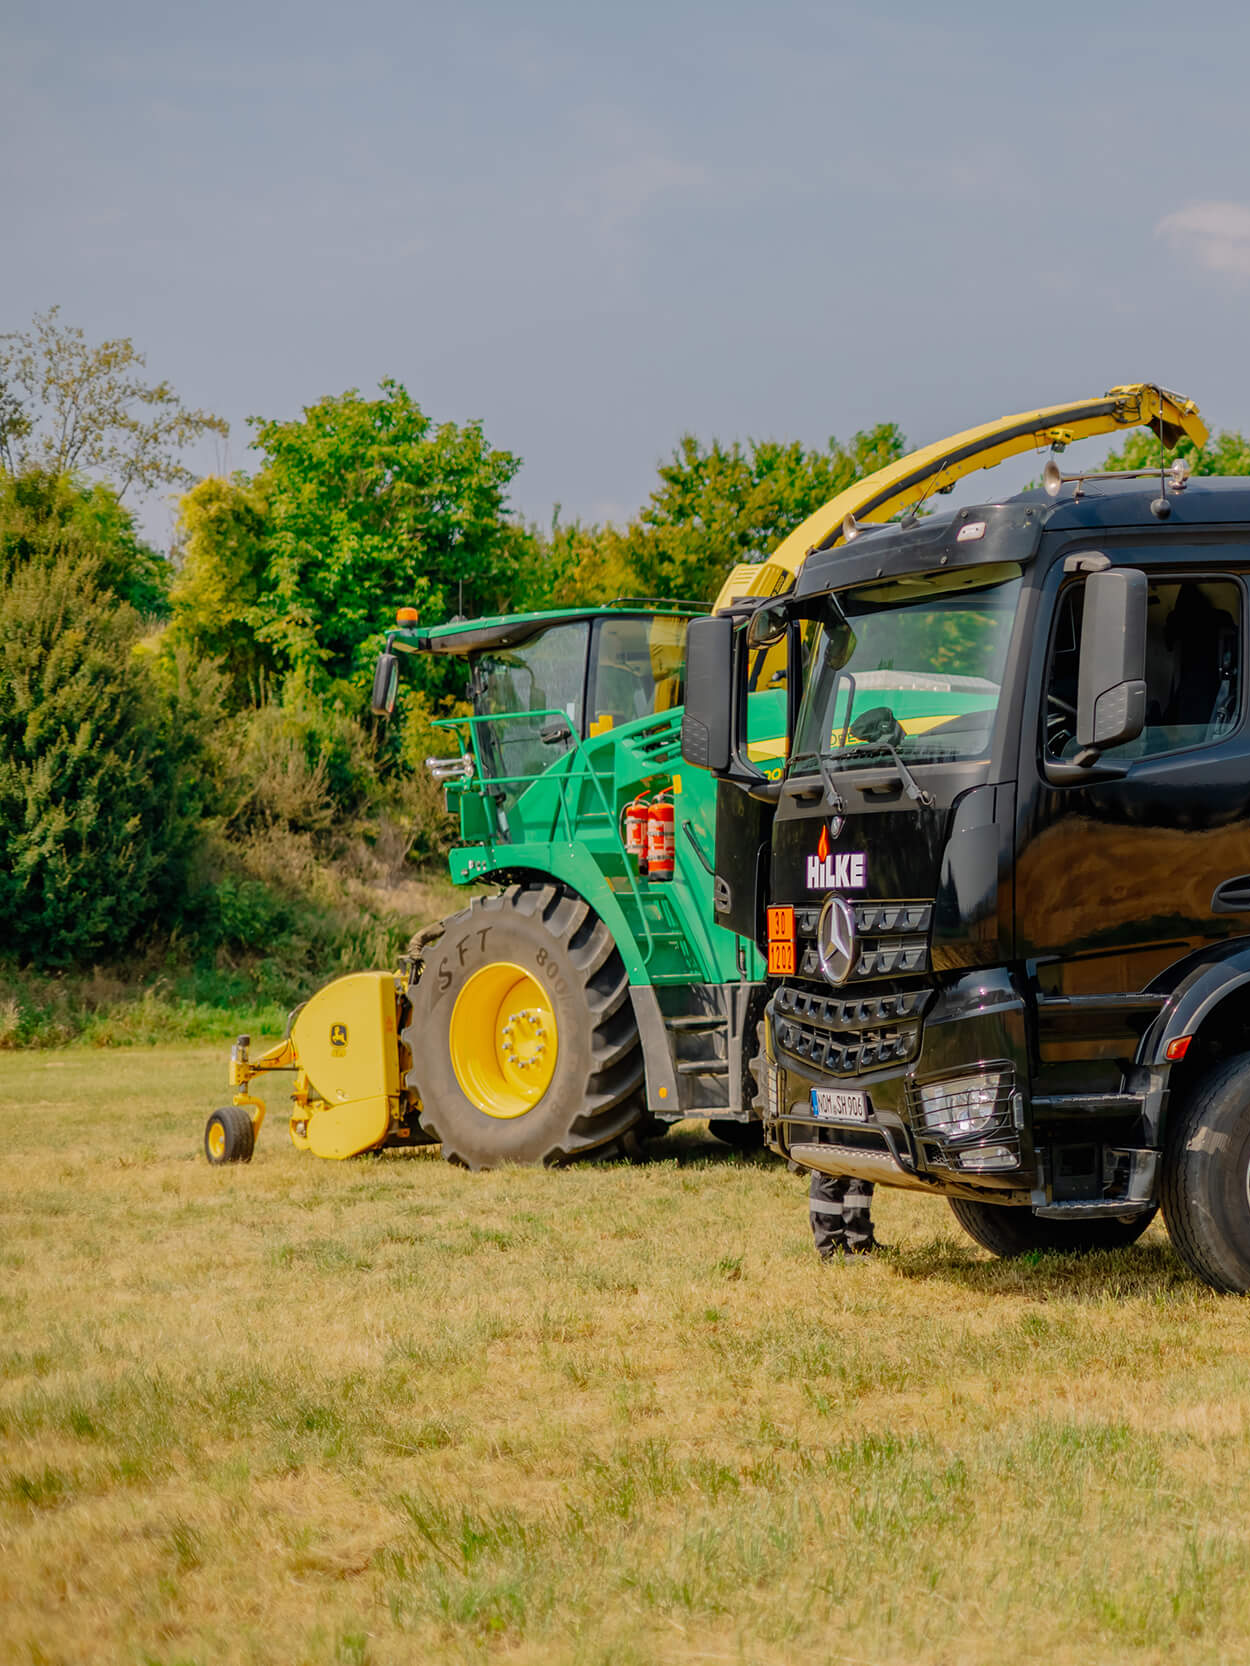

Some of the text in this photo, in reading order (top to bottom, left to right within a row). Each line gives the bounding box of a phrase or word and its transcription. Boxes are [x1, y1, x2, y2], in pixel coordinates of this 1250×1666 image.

[775, 911, 785, 935] 30
[438, 926, 493, 991] SFT
[771, 945, 792, 970] 1202
[836, 1095, 848, 1115] SH
[847, 1096, 863, 1116] 906
